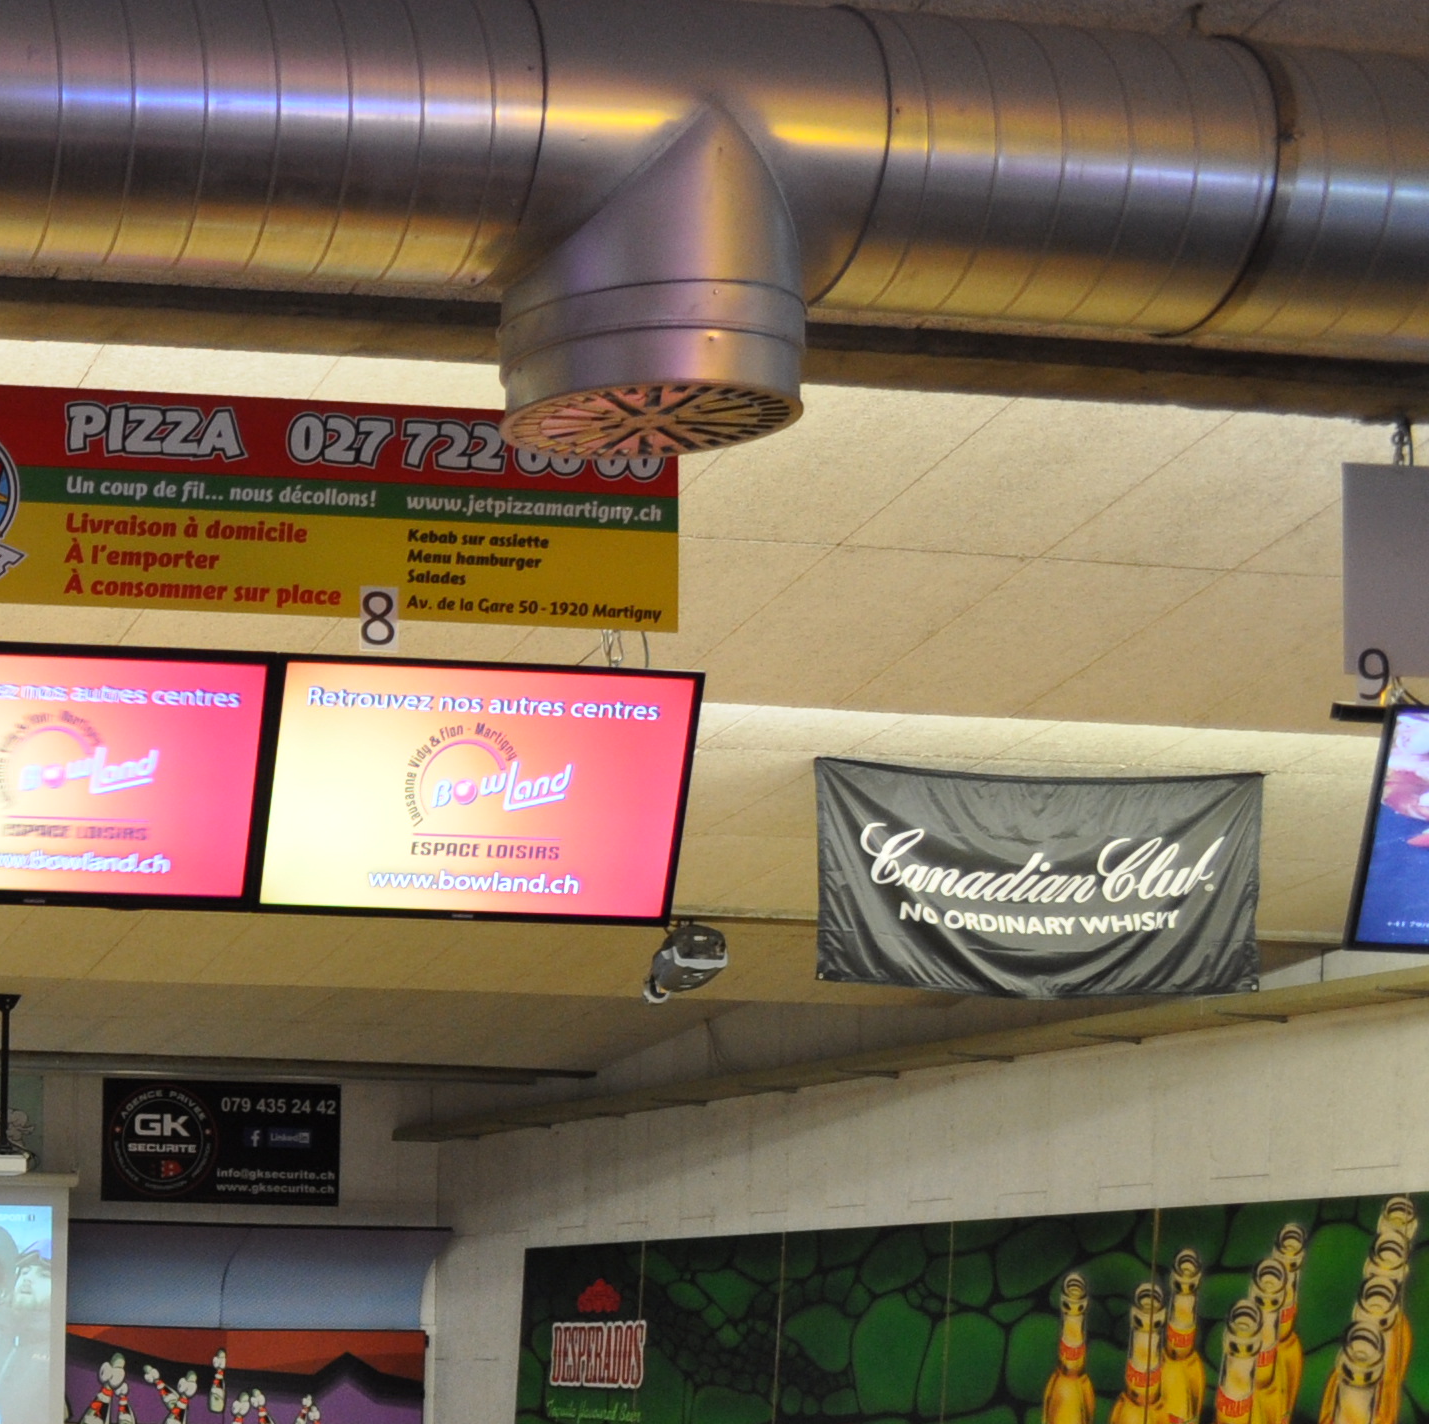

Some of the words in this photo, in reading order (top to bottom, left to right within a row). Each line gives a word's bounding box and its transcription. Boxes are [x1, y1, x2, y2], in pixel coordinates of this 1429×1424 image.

[64, 403, 247, 462] PIZZA
[287, 412, 395, 468] 027
[402, 417, 508, 474] 722
[66, 476, 94, 494] Un
[101, 481, 147, 501] coup
[153, 481, 177, 498] de
[182, 482, 223, 503] fil...
[230, 487, 273, 502] nous
[279, 483, 376, 508] décollons!
[406, 494, 662, 525] www.jetpizzamartigny.ch
[66, 513, 177, 539] Livraison
[185, 515, 198, 538] à
[205, 517, 307, 544] domicile
[407, 528, 458, 545] Kebab
[462, 534, 485, 545] sur
[489, 534, 549, 549] assiette
[91, 546, 220, 572] l'emporter
[407, 549, 452, 566] Menu
[456, 552, 542, 571] hamburger
[407, 570, 466, 587] Salades
[91, 581, 228, 602] consommer
[234, 585, 269, 603] sur
[276, 584, 341, 608] place
[361, 590, 395, 646] 8
[407, 595, 433, 611] Av.
[437, 597, 455, 611] de
[478, 599, 514, 614] Gare
[518, 600, 538, 615] 50
[549, 601, 589, 617] 1920
[592, 603, 662, 624] Martigny
[1358, 647, 1390, 700] 9
[151, 689, 242, 708] centres
[306, 686, 433, 713] Retrouvez
[438, 696, 482, 714] nos
[488, 697, 564, 717] autres
[570, 701, 660, 722] centres
[475, 721, 519, 762] Martigny
[410, 841, 480, 858] ESPACE
[486, 844, 561, 861] LOISIRS
[860, 822, 1097, 904] Canadian
[1097, 836, 1225, 903] Club
[367, 869, 580, 896] www.bowland.ch
[900, 901, 938, 925] NO
[943, 909, 1076, 935] ORDINARY
[1079, 910, 1180, 935] WHISKY
[221, 1097, 251, 1113] 079
[256, 1098, 287, 1114] 435
[291, 1099, 311, 1114] 24
[316, 1100, 336, 1115] 42
[134, 1113, 191, 1137] GK
[128, 1143, 197, 1153] SECURITE
[216, 1167, 335, 1181] info@gksecurite.ch
[550, 1320, 646, 1389] DESPERADOS
